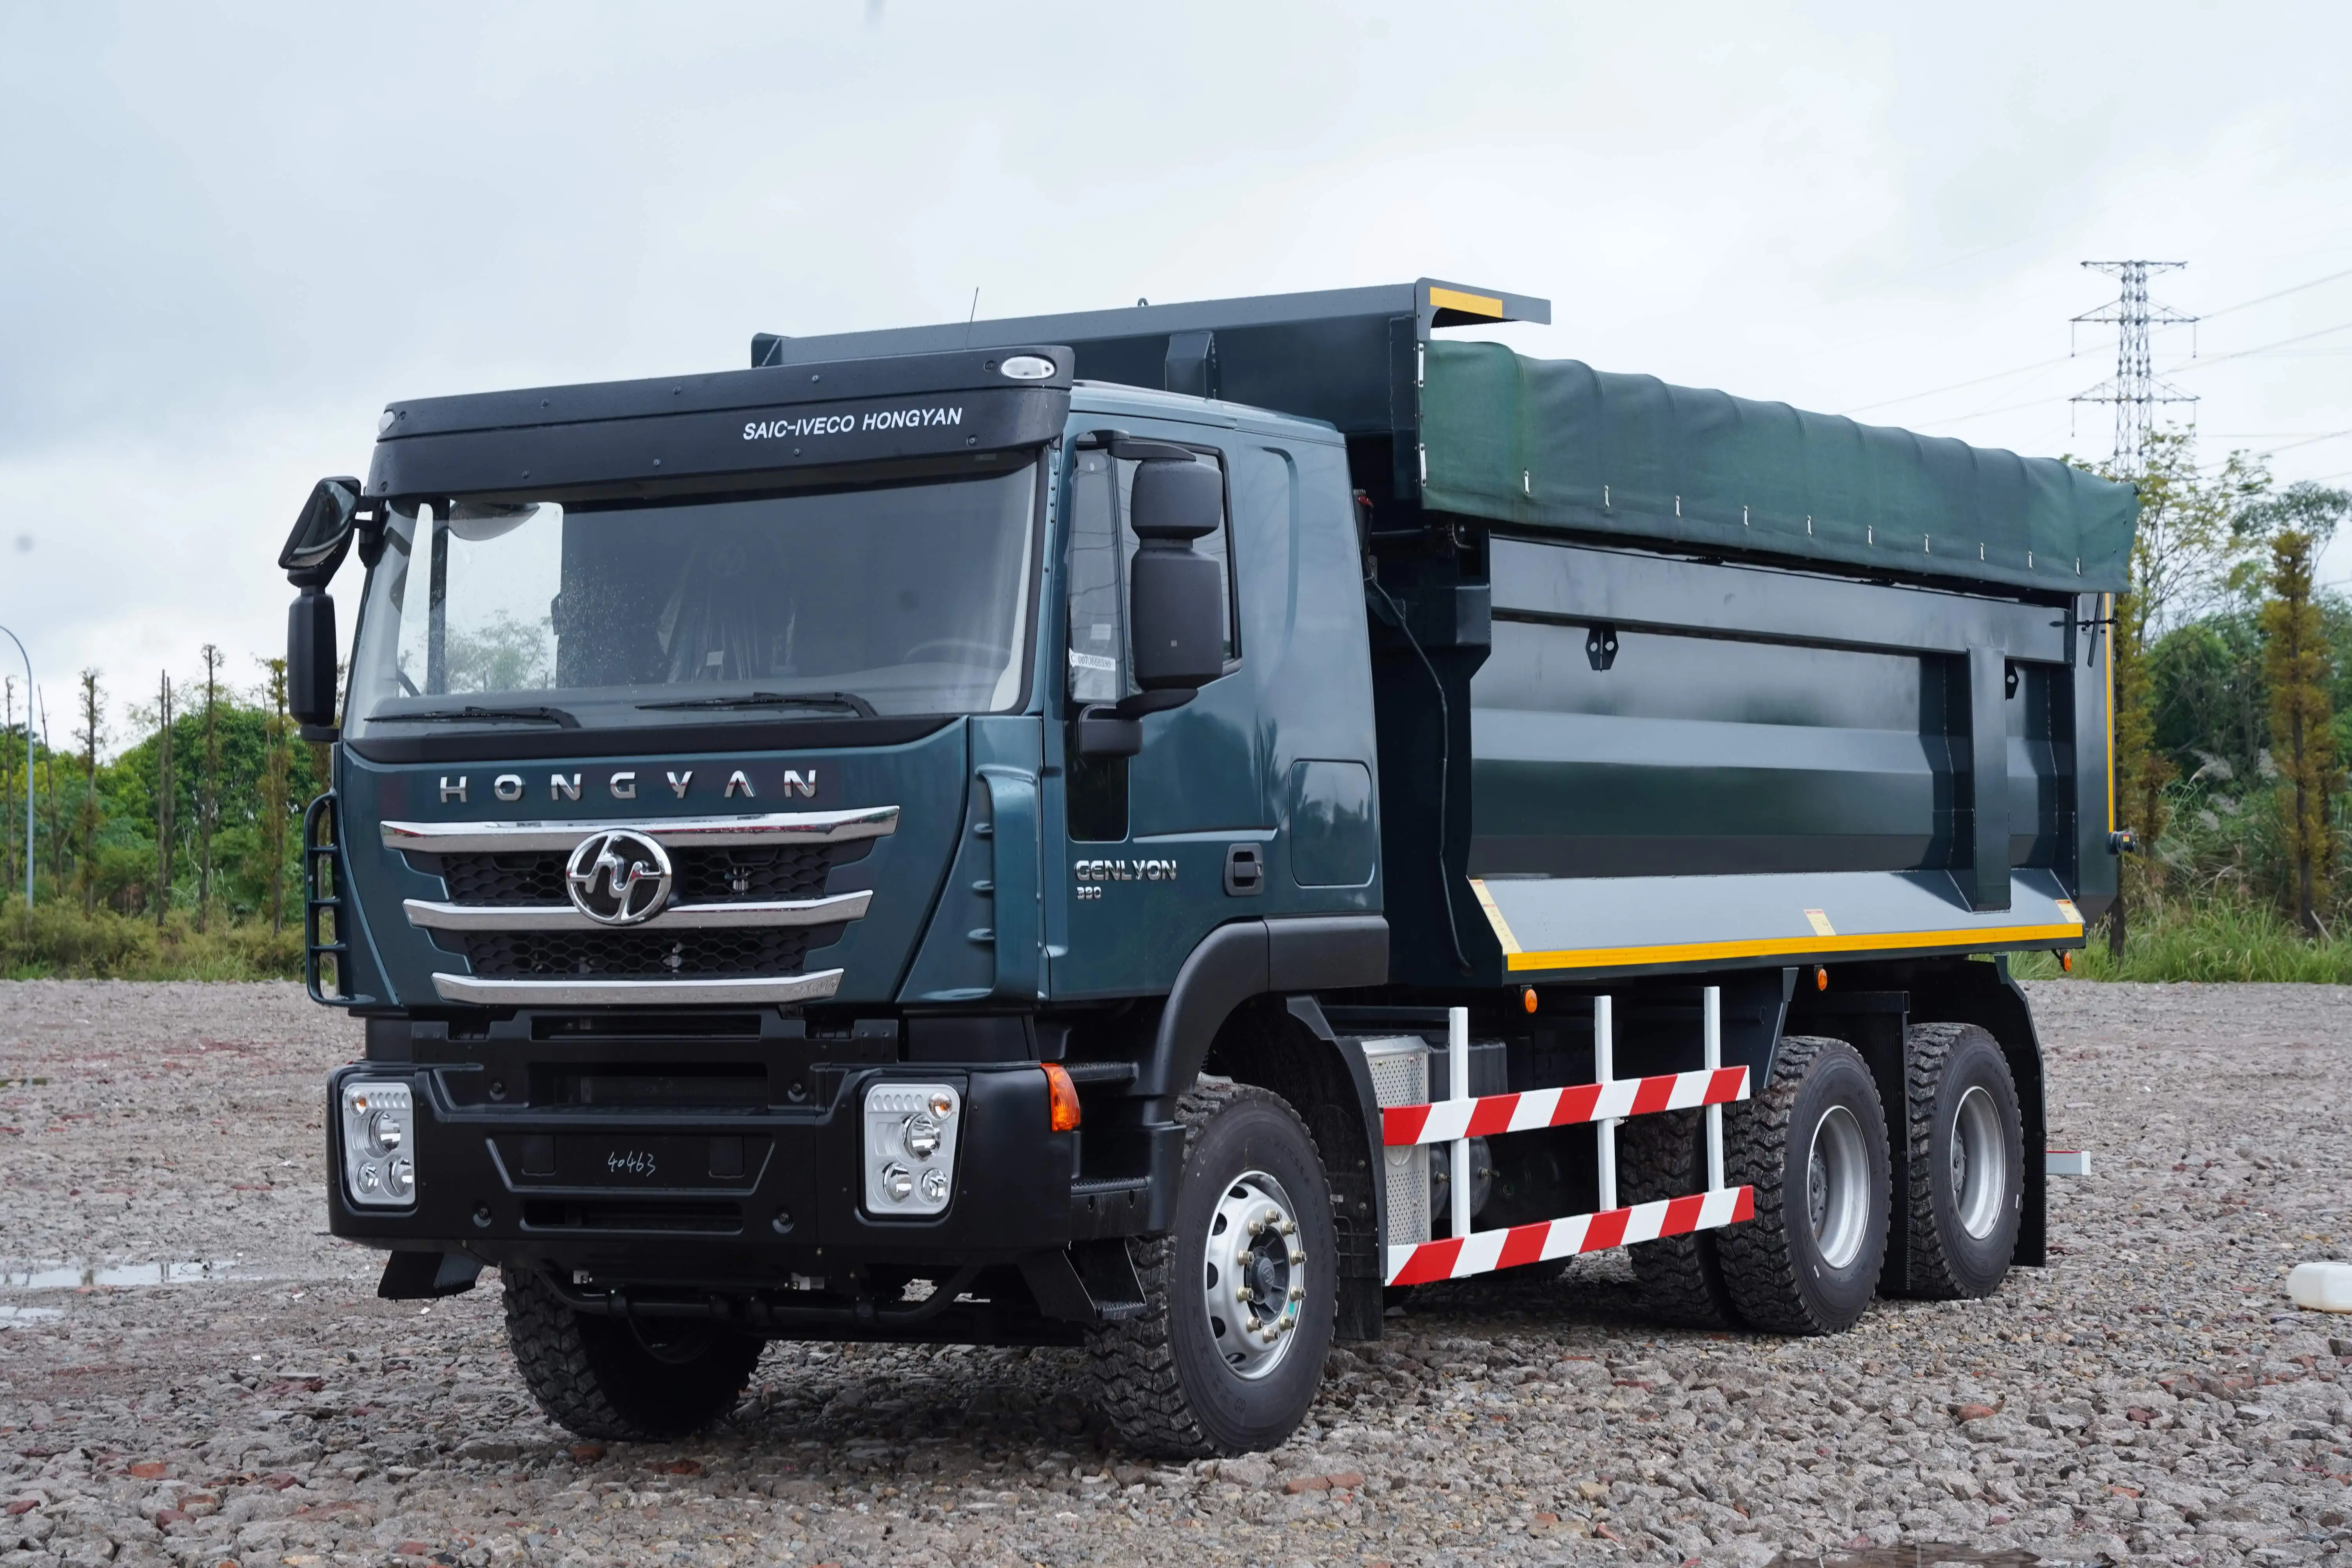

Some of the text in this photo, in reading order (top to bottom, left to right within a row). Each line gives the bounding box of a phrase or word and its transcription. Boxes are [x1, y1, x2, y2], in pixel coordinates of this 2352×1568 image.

[743, 407, 962, 440] SAIC-IVECO HONGYAN
[439, 769, 817, 803] HONGYAN
[1074, 860, 1177, 880] GENLYON
[608, 1151, 655, 1177] 40463
